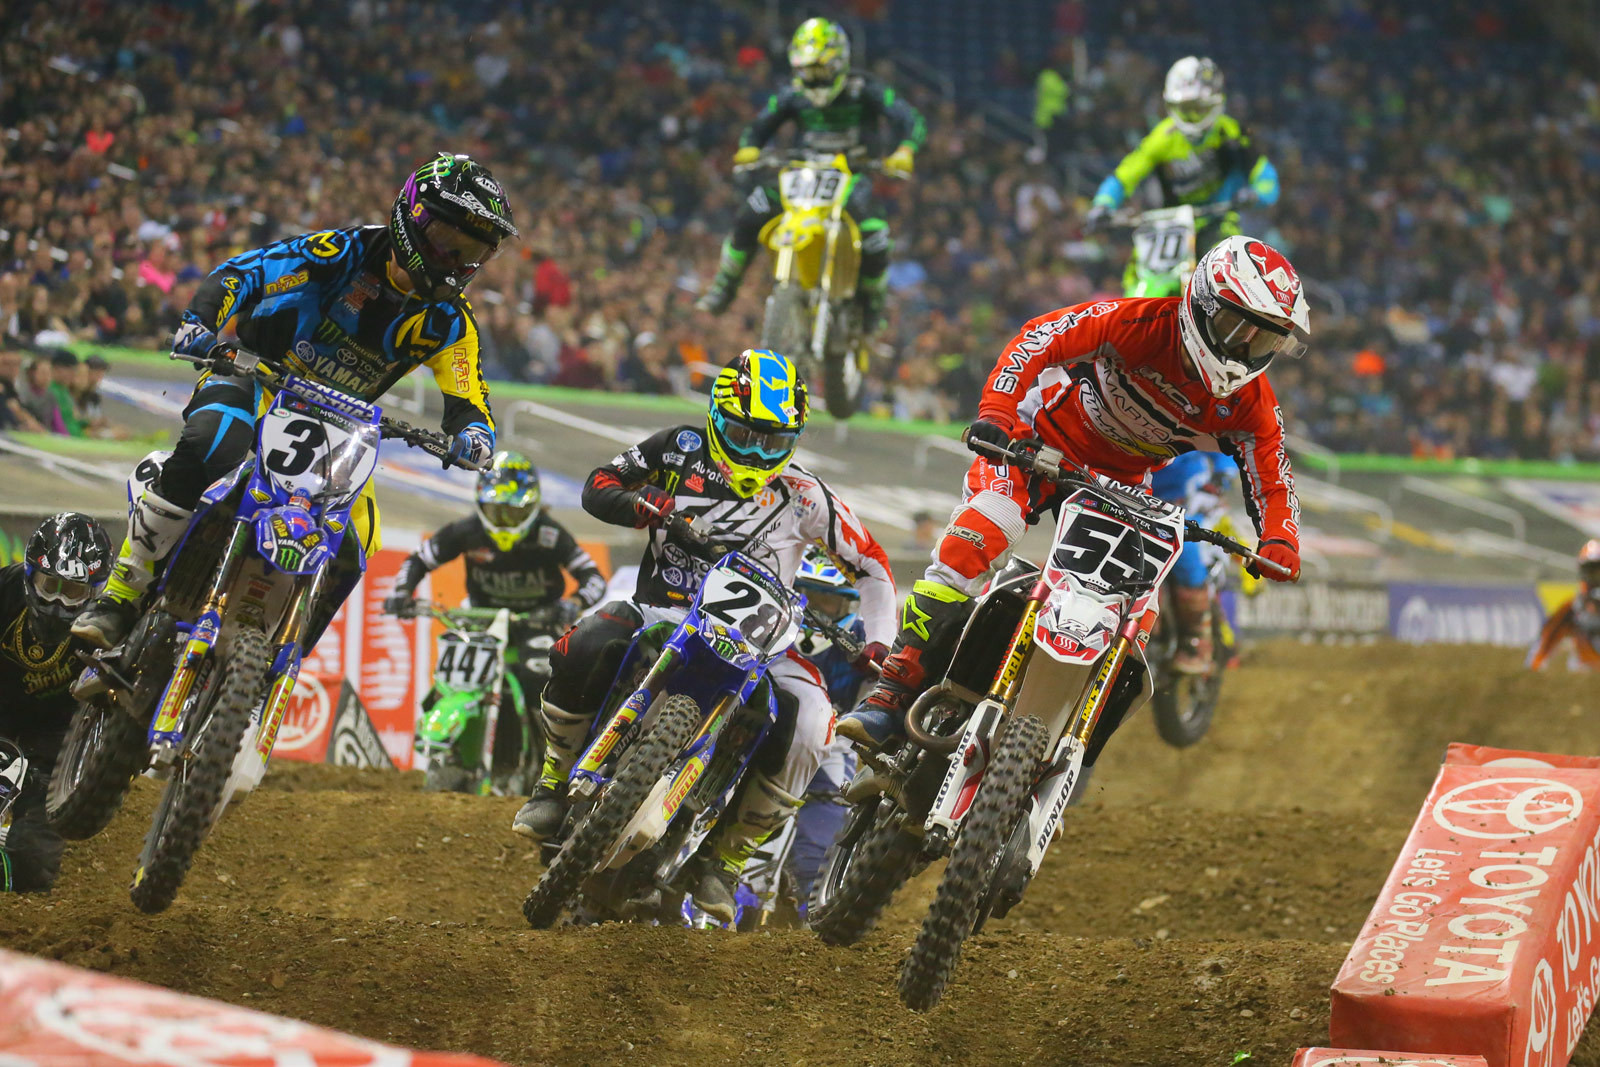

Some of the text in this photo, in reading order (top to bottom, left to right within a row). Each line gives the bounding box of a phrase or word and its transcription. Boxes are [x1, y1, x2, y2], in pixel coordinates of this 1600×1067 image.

[313, 356, 376, 393] YAMAH
[277, 538, 307, 555] YAMAHA
[744, 521, 781, 556] ACING
[1054, 513, 1173, 586] 55
[1110, 507, 1151, 530] MOTER
[698, 581, 788, 652] 28
[439, 645, 498, 684] 447
[662, 764, 699, 815] PIRELLI
[935, 730, 972, 810] DUNLOP
[1037, 769, 1075, 852] DUNLOP
[1359, 848, 1462, 985] Let's Go Places
[1424, 846, 1559, 987] TOYOTA
[1556, 834, 1600, 993] TOYO
